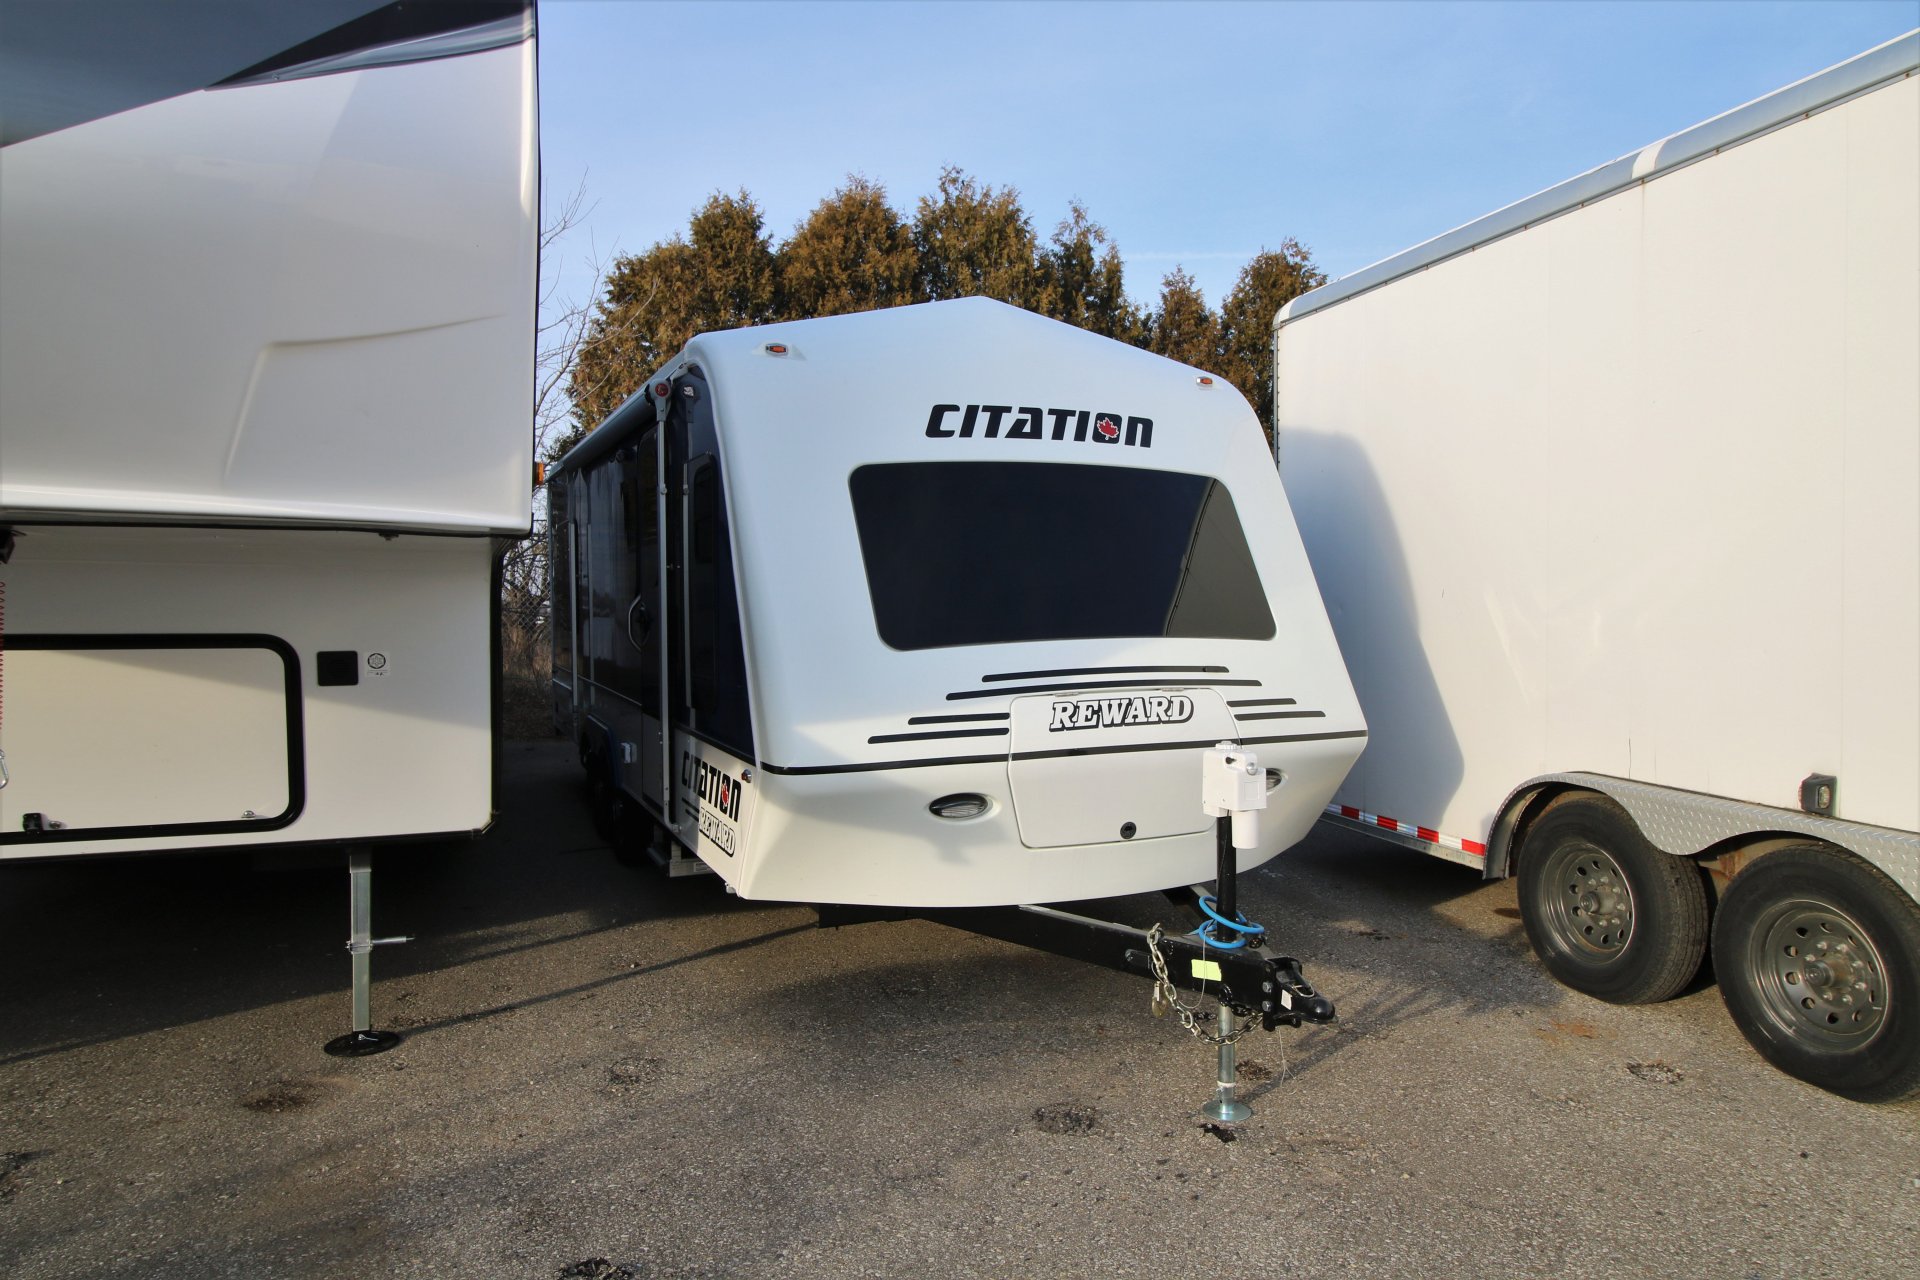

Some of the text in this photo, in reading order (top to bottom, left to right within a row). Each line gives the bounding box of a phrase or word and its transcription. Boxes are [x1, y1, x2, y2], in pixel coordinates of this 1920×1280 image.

[925, 404, 1154, 448] CITATION
[1049, 695, 1194, 732] REWARD
[681, 750, 742, 823] CITATION
[699, 806, 736, 858] REWARD
